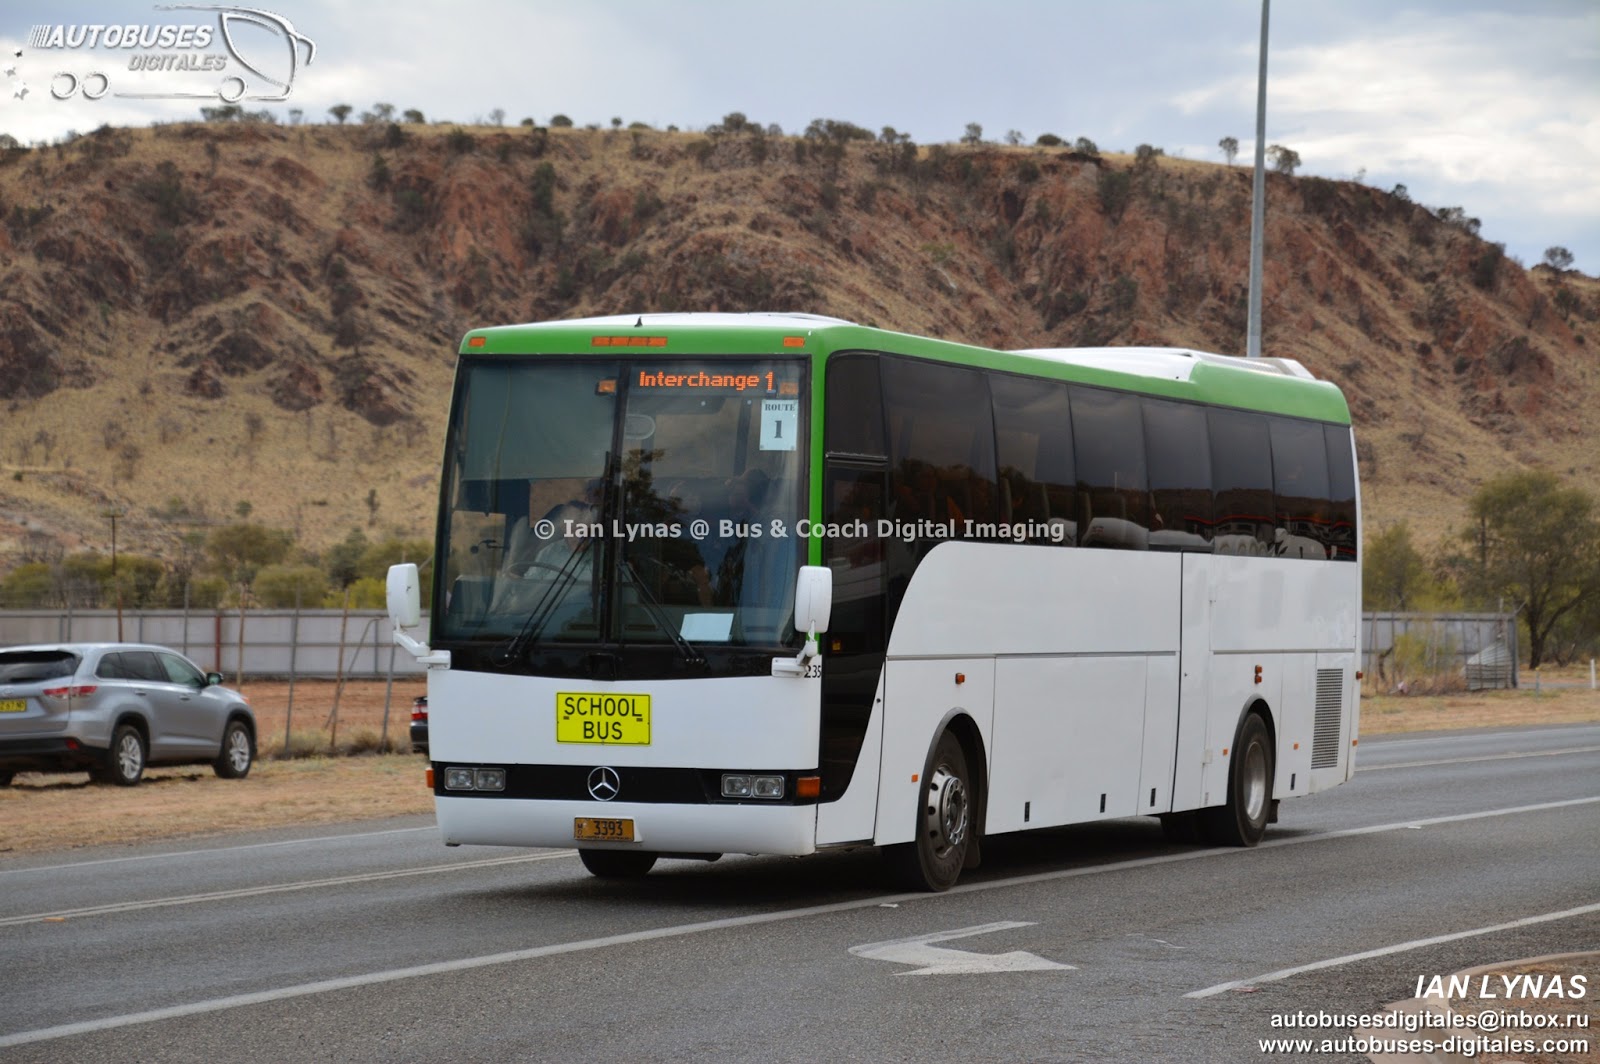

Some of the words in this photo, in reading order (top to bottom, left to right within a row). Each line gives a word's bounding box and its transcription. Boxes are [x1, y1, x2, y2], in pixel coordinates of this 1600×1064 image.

[639, 371, 760, 391] Interchange
[765, 371, 774, 391] 1
[764, 403, 796, 412] ROUTE
[773, 420, 783, 439] 1
[564, 696, 643, 717] SCHOOL
[583, 720, 623, 740] BUS
[594, 820, 623, 836] 3393
